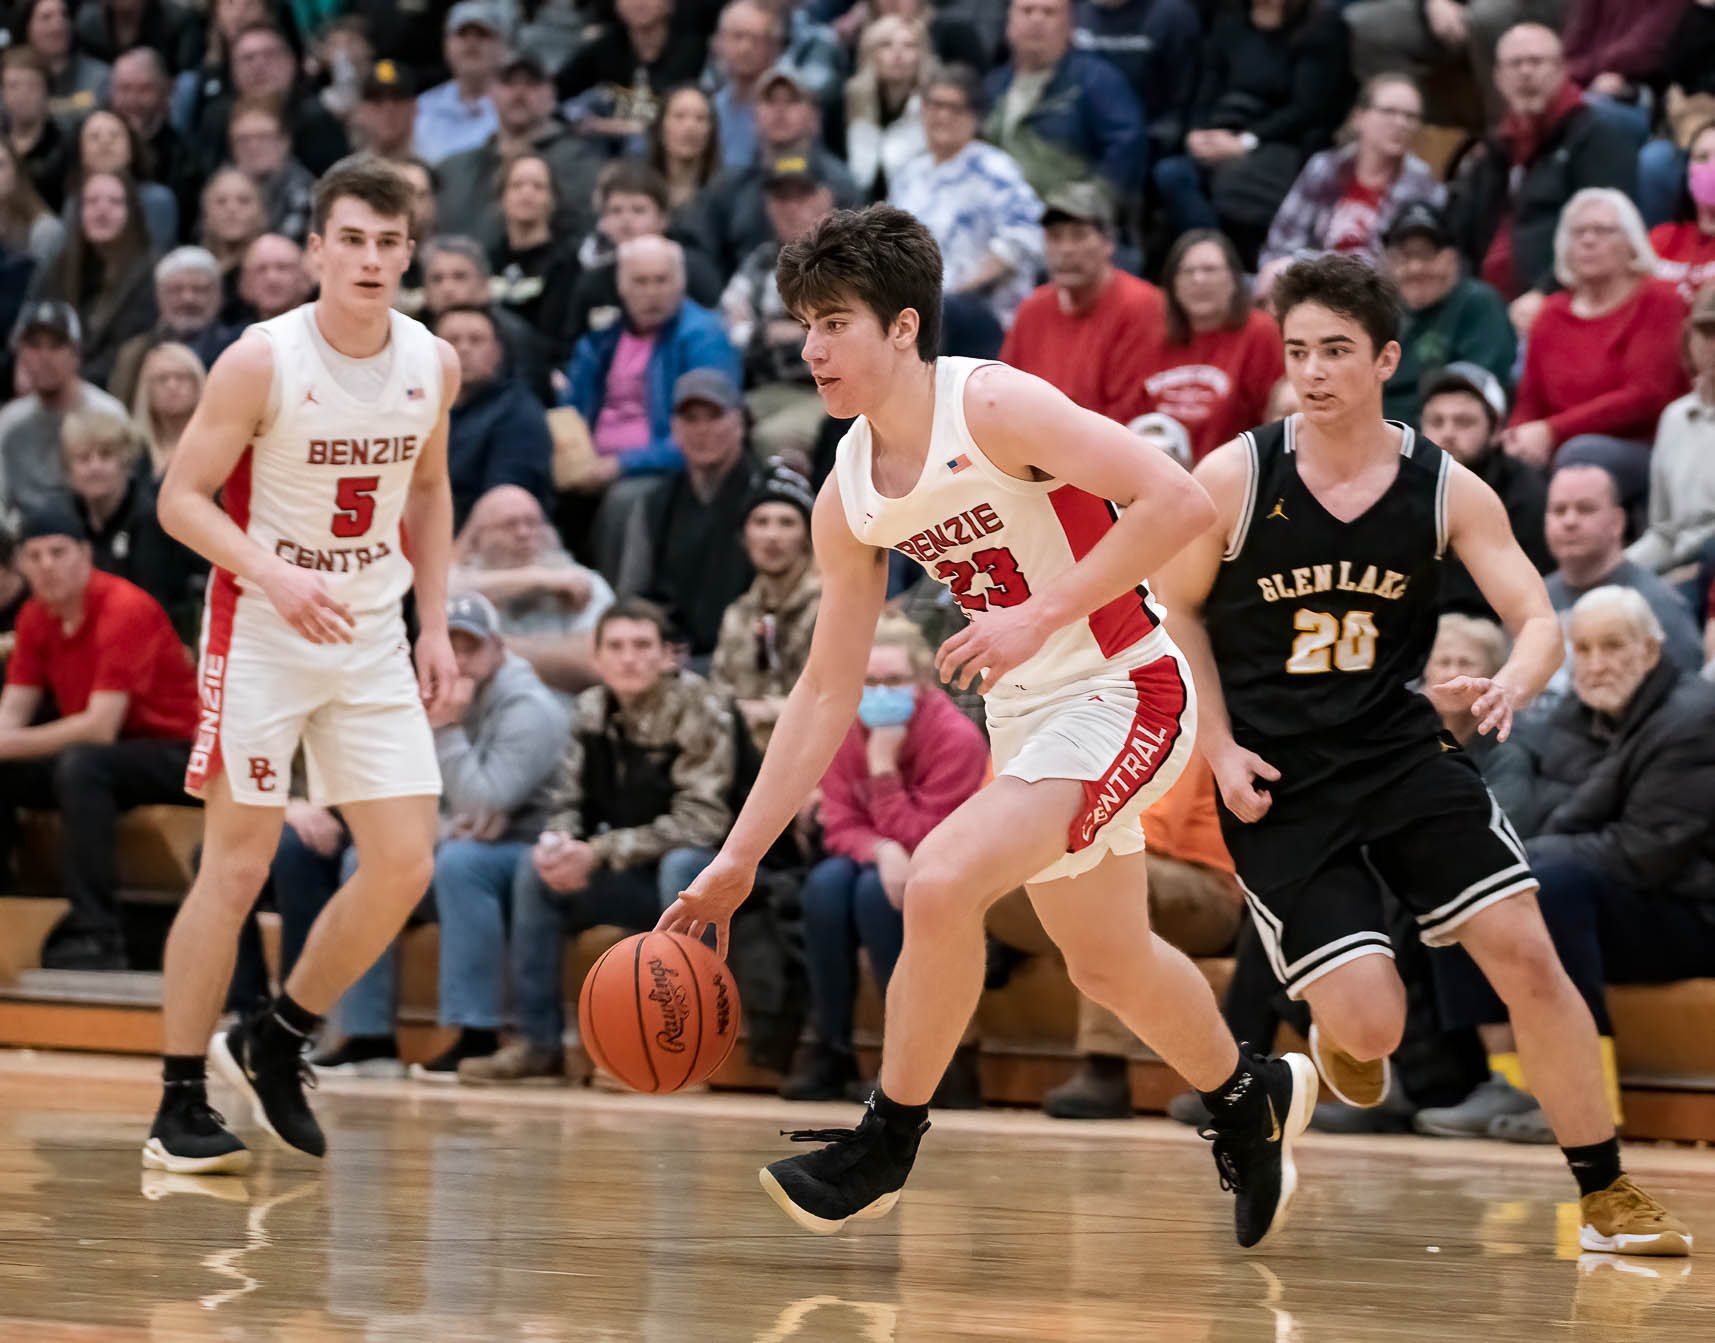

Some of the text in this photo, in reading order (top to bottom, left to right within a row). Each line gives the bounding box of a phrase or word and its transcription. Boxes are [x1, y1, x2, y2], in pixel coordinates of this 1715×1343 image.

[306, 434, 417, 465] BENZIE
[331, 475, 381, 538] 5
[894, 502, 1005, 562] BENZIE
[934, 547, 1033, 612] 23
[1257, 563, 1333, 602] GLEN
[1286, 607, 1380, 674] 20
[188, 655, 225, 776] BENZIE
[1082, 724, 1167, 841] CENTRAL
[647, 956, 686, 1054] Rawlings
